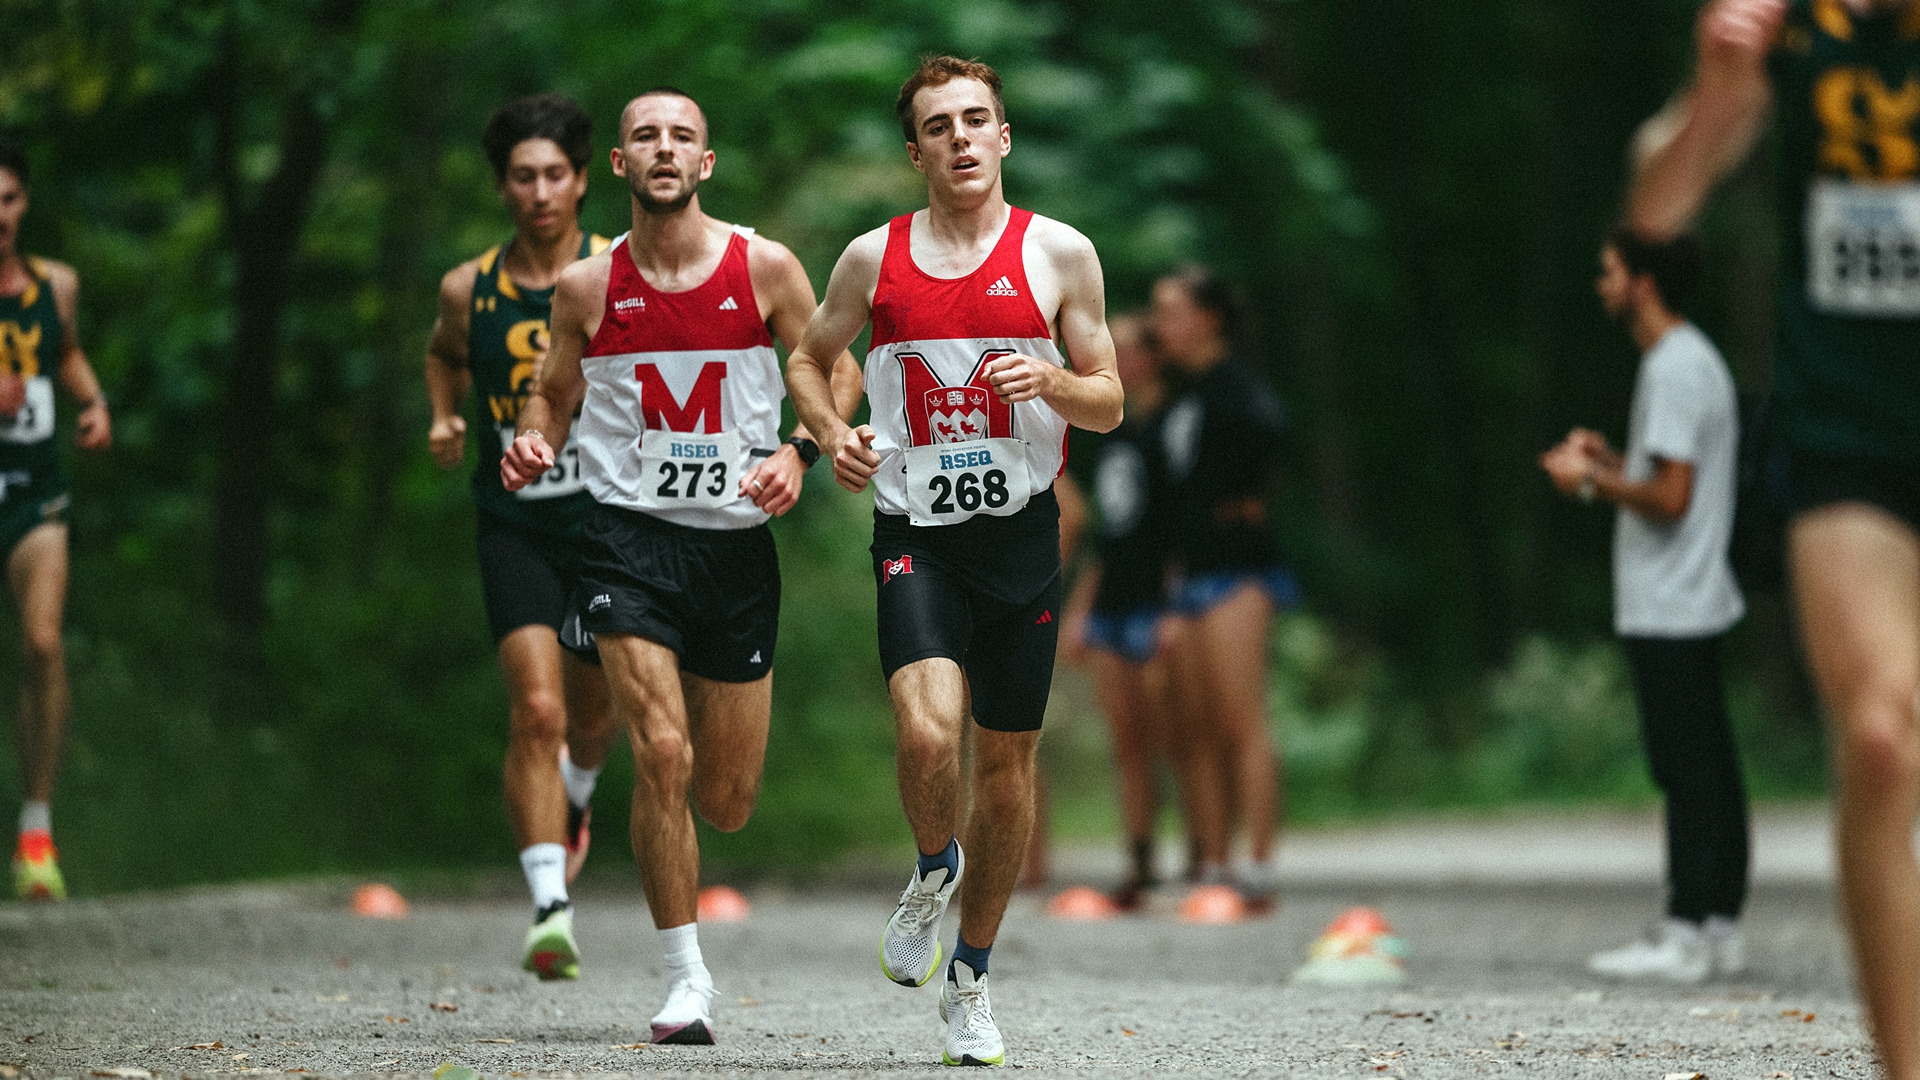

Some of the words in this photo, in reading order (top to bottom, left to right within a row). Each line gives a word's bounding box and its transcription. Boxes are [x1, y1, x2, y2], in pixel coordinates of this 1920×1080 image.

[986, 287, 1018, 297] adidas
[635, 361, 727, 436] M
[670, 443, 719, 458] RSEQ
[939, 450, 993, 470] RSEQ
[657, 461, 727, 498] 273
[928, 469, 1010, 514] 268
